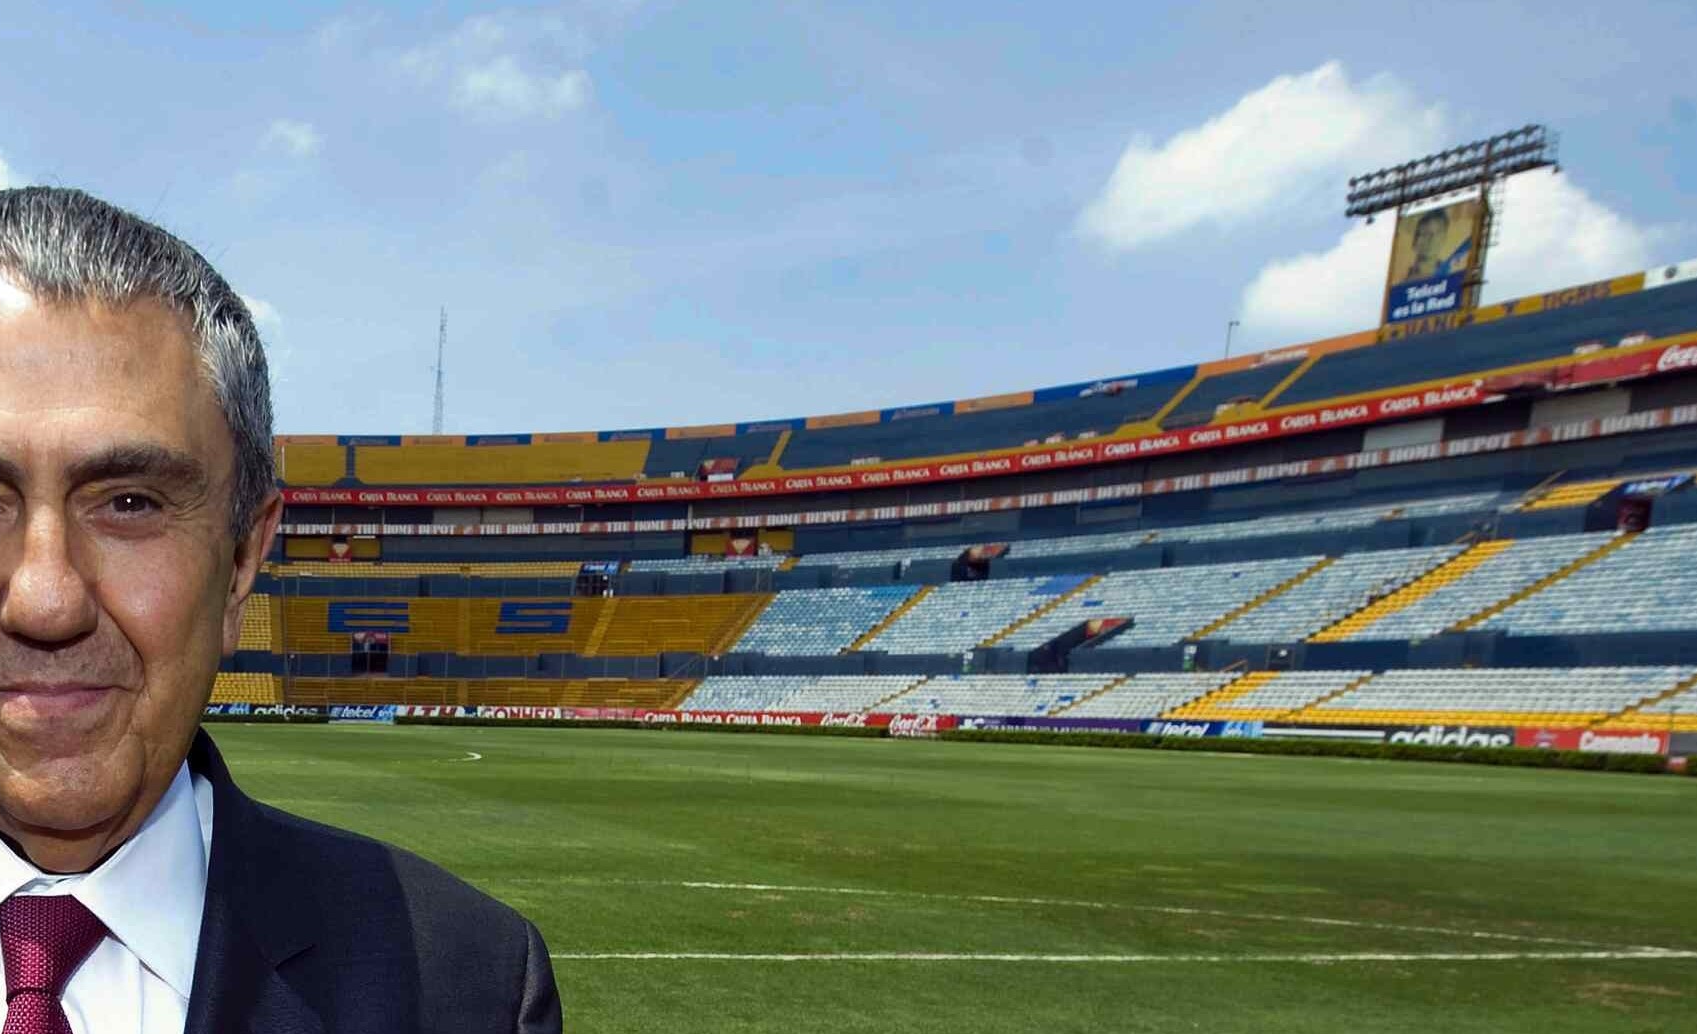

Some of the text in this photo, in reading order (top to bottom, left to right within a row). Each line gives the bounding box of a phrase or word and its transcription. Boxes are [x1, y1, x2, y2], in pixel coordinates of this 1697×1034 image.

[341, 705, 378, 718] telcel
[645, 711, 677, 723] CARTA
[681, 713, 722, 724] BLANCA
[726, 713, 802, 726] CARTA BLANCA
[1390, 725, 1511, 748] adidas
